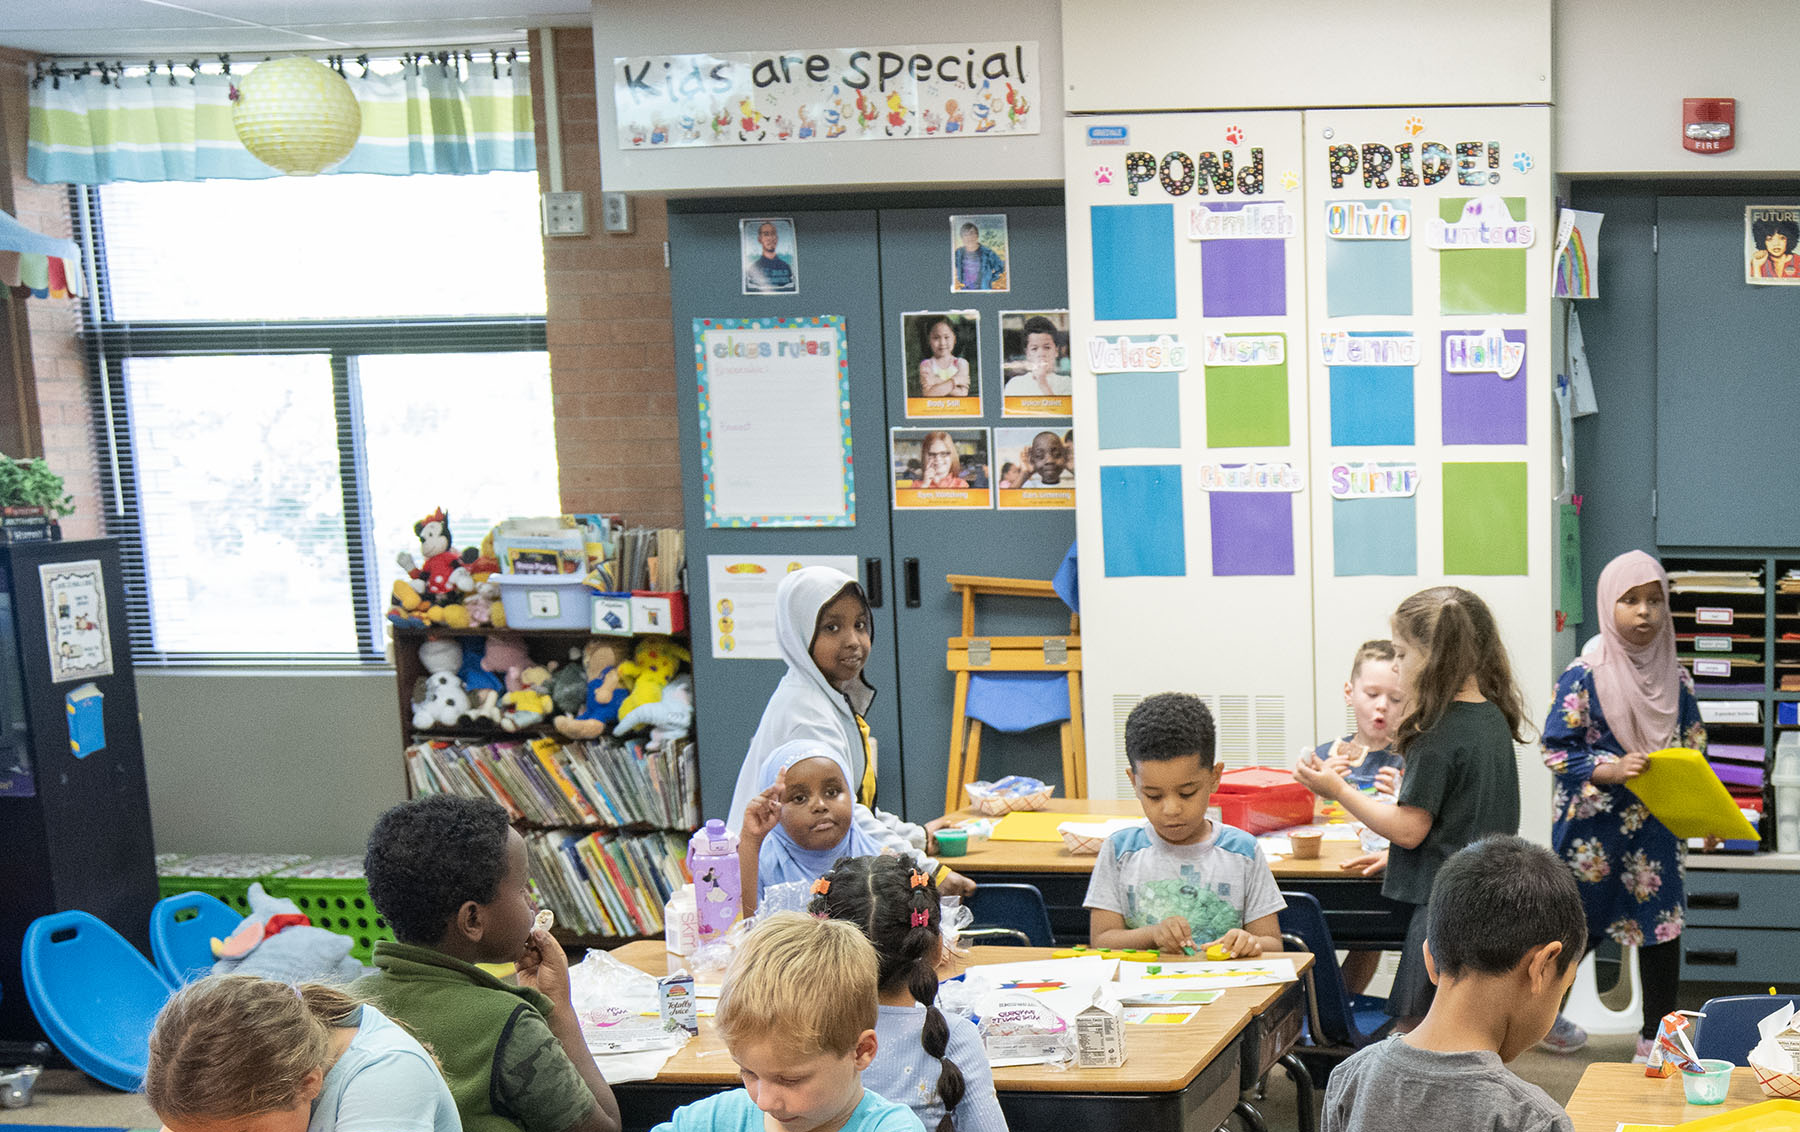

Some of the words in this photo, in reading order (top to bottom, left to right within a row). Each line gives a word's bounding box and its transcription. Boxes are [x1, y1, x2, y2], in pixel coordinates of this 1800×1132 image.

[624, 60, 734, 102] Kids
[752, 52, 830, 88] are
[841, 45, 1026, 93] special
[1329, 141, 1500, 189] PRIDE!
[1329, 204, 1407, 235] Olivia
[1753, 212, 1800, 221] FUTURE
[1431, 221, 1531, 244] umtaas
[668, 1001, 692, 1010] Totally
[669, 1008, 689, 1016] Juice
